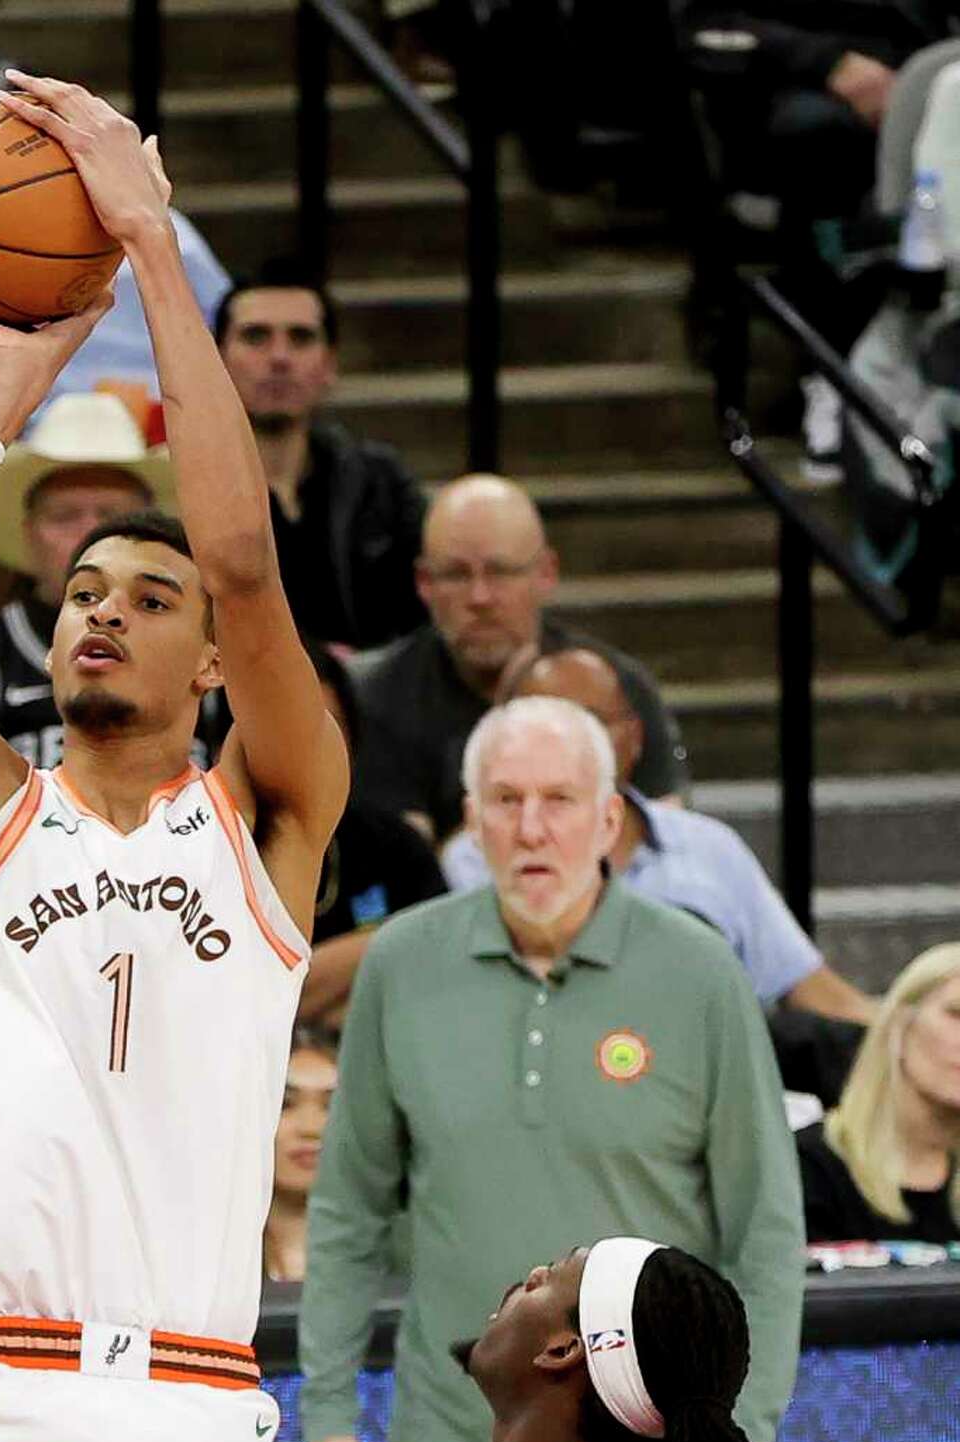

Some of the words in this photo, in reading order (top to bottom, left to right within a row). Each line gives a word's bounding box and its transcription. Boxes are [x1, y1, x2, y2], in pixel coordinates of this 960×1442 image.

[165, 805, 210, 836] elf.
[5, 883, 88, 953] SAN
[96, 869, 231, 962] ANTONIO
[99, 952, 133, 1072] 1
